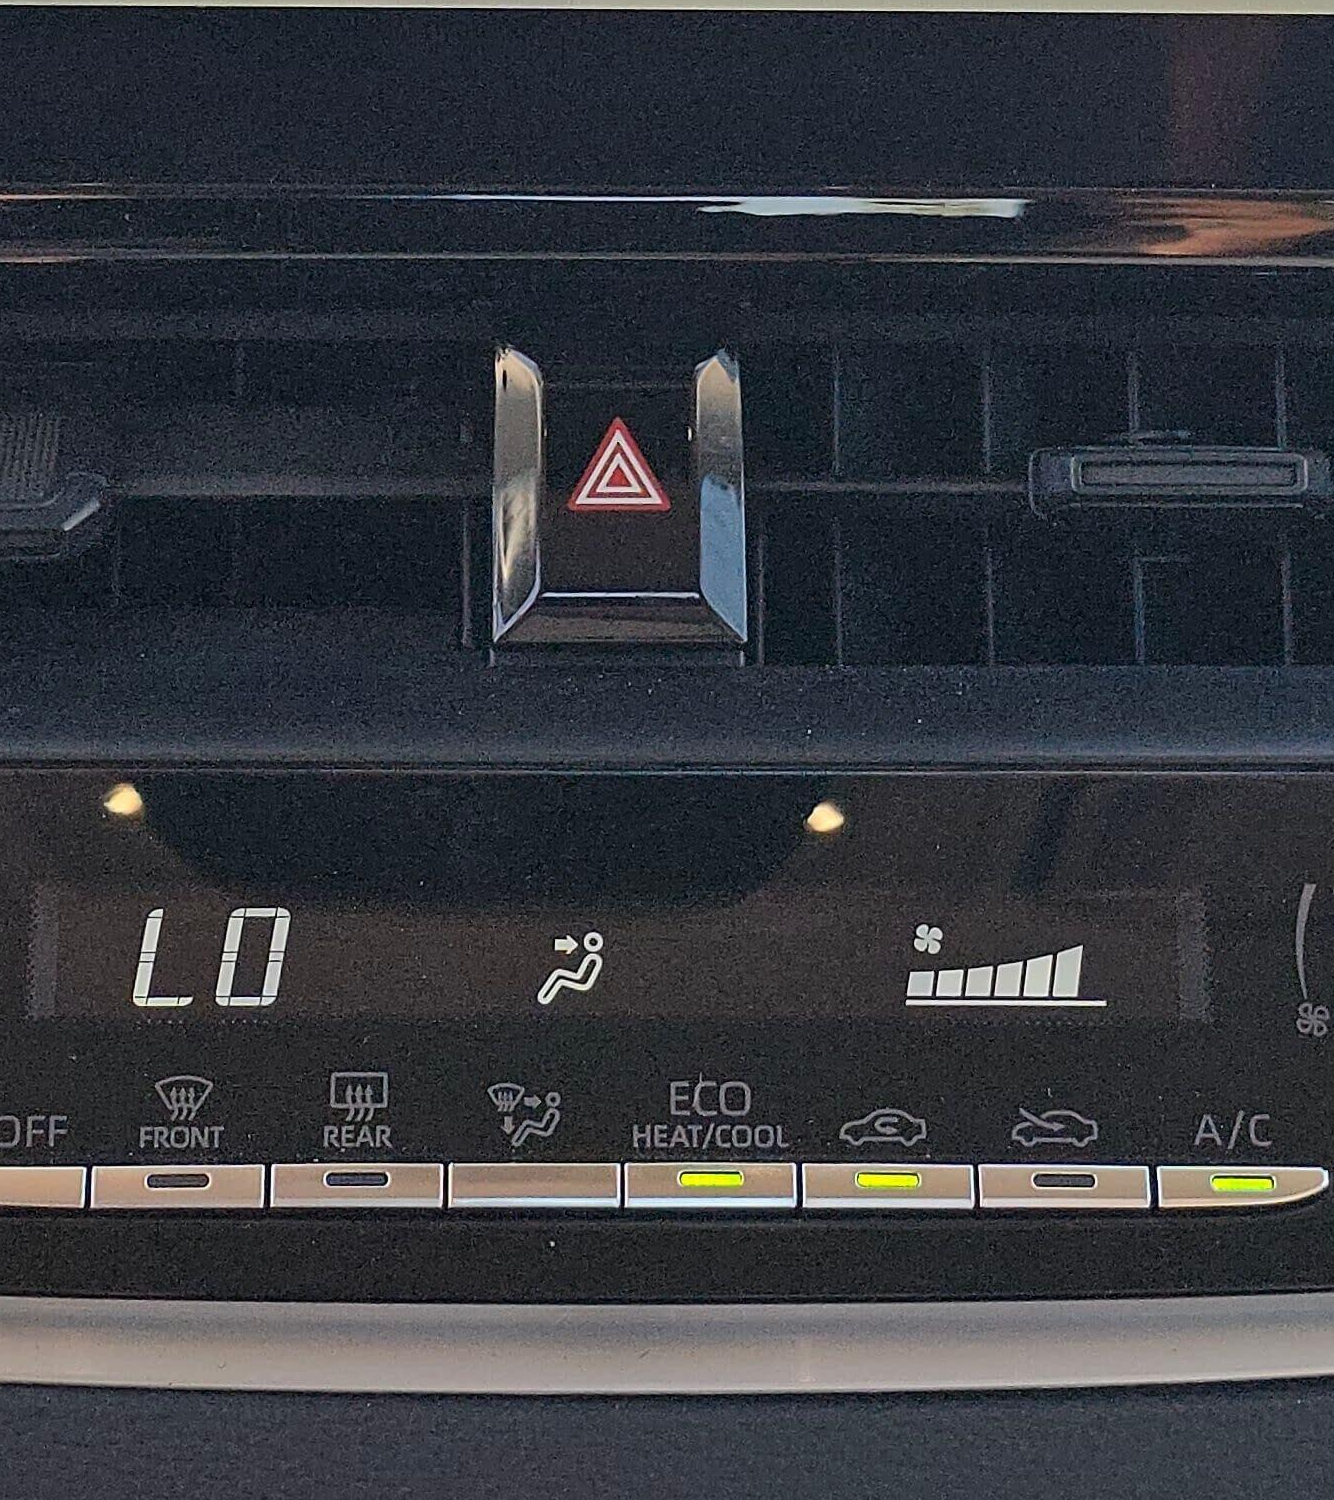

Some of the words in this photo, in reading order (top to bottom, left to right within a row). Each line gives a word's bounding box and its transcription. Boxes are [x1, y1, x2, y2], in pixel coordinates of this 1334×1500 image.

[132, 907, 292, 1007] LO
[669, 1081, 752, 1117] ECO
[139, 1125, 225, 1149] FRONT
[323, 1125, 393, 1148] REAR
[632, 1122, 790, 1150] HEAT/COOL
[1194, 1113, 1273, 1147] A/C
